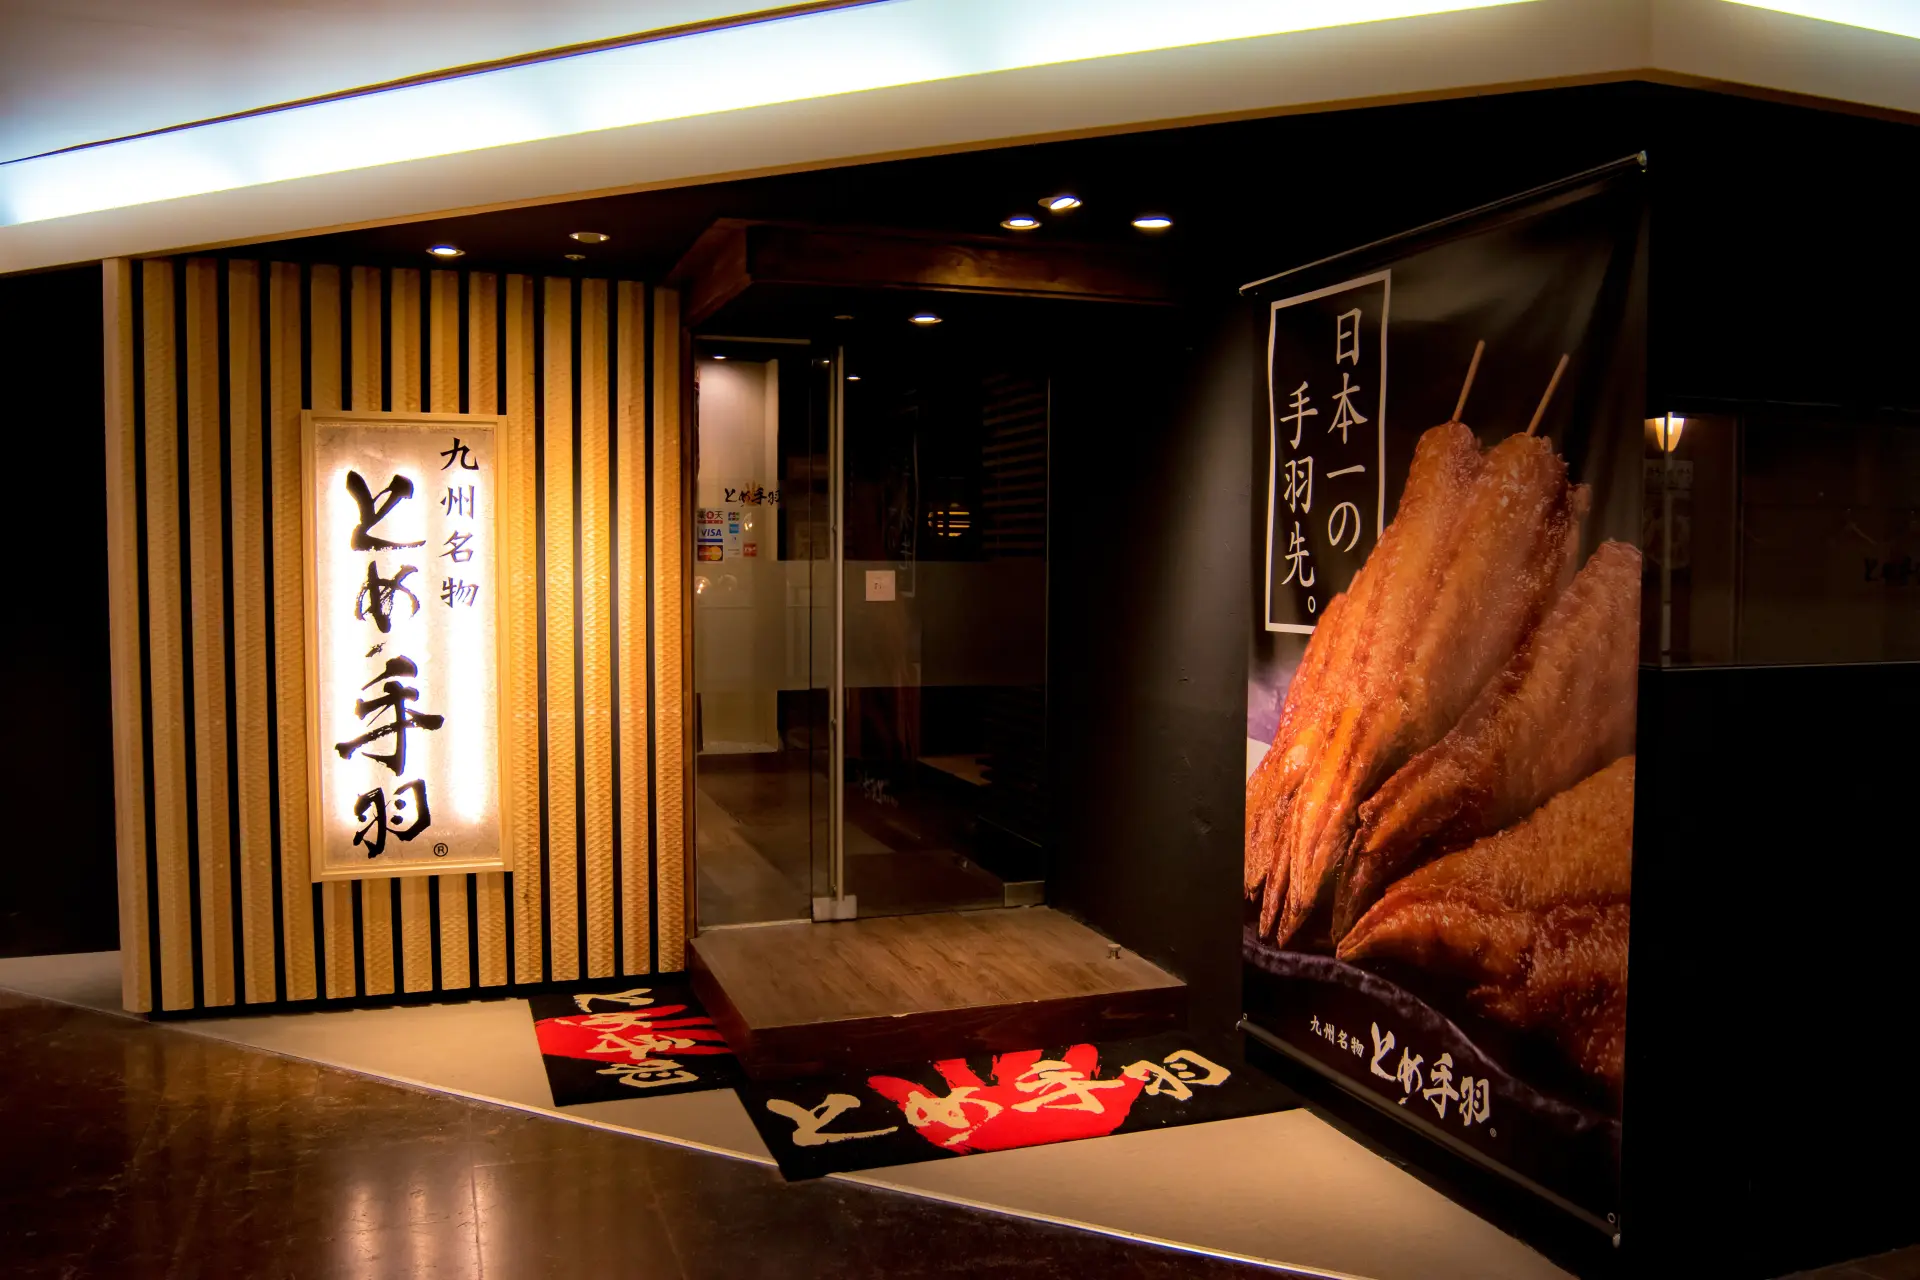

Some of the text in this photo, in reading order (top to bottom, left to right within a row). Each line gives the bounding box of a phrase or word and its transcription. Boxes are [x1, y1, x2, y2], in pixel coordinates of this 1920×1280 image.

[1280, 380, 1318, 614] 手羽先。
[1326, 307, 1368, 553] 日本一の
[439, 437, 480, 608] 九州名物
[701, 528, 722, 537] VISA
[335, 469, 445, 859] とめ手羽
[766, 1048, 1232, 1147] とめ手羽
[1309, 1014, 1491, 1127] 九州名物 とめ手羽
